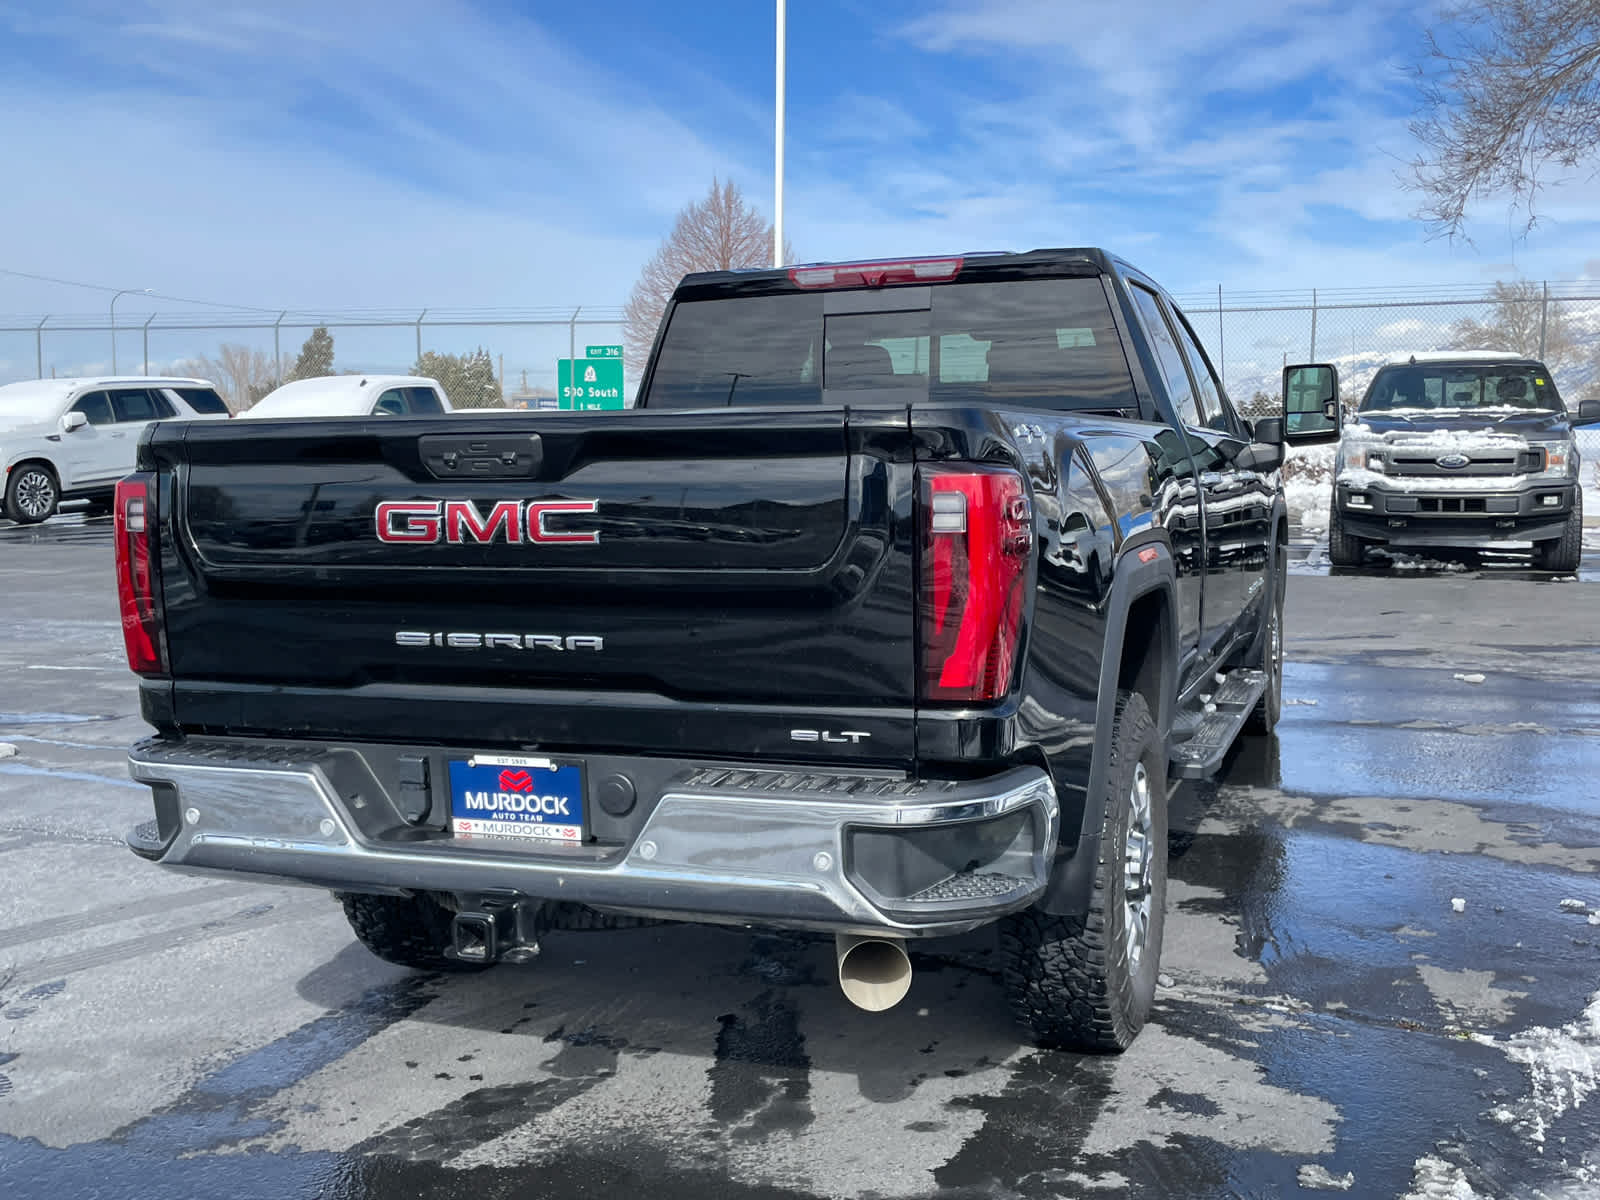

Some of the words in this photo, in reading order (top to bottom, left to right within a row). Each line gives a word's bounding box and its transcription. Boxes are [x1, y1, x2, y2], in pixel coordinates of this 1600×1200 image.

[606, 348, 619, 356] 316
[588, 386, 618, 397] South
[376, 499, 600, 545] GMC
[395, 632, 604, 650] SIERRA
[790, 730, 871, 743] SLT
[464, 792, 570, 816] MURDOCK
[520, 814, 543, 822] TEAM
[483, 824, 552, 836] MURDOCK
